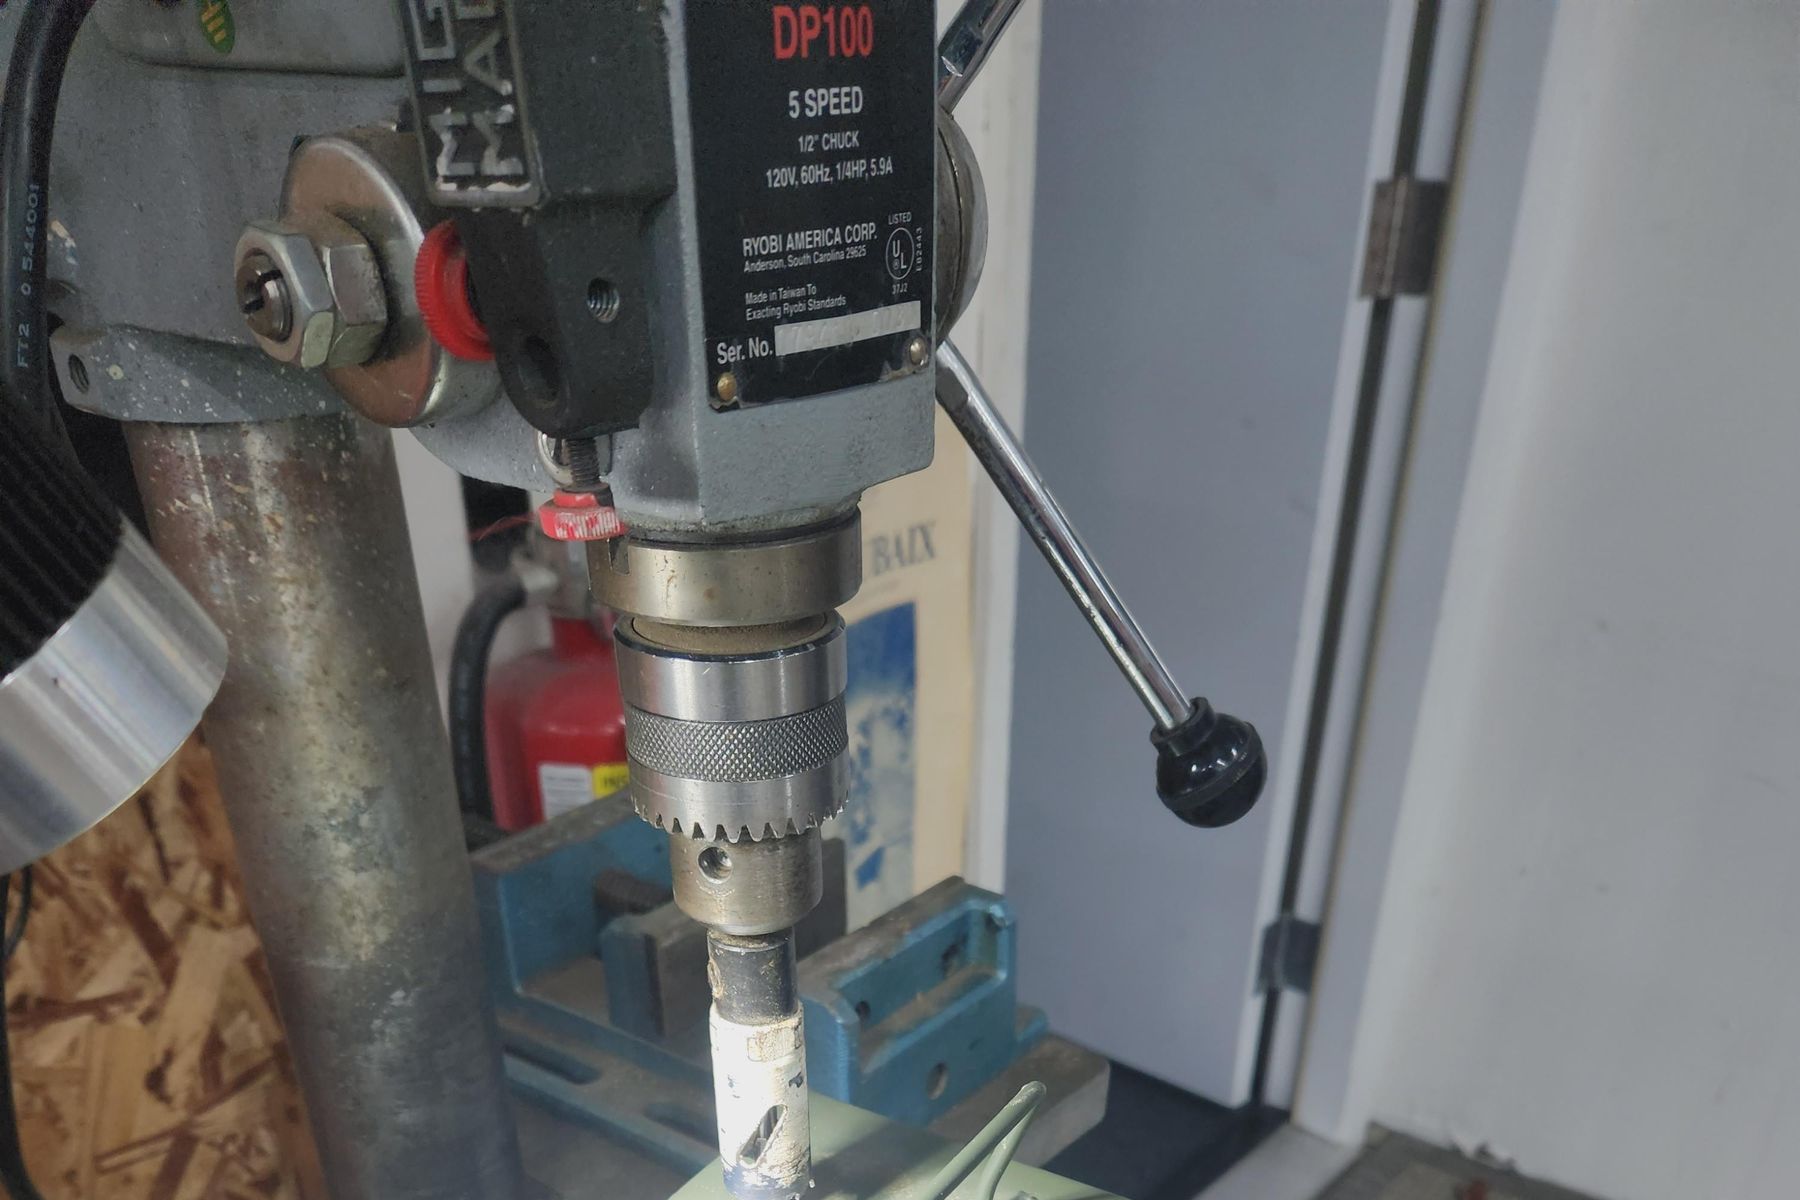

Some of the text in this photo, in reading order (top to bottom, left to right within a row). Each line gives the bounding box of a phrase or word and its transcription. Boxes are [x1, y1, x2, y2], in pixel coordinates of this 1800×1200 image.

[773, 5, 873, 59] DP100
[788, 86, 863, 119] 5 SPEED
[798, 131, 860, 152] 1/2" CHUCK
[766, 156, 893, 188] 120V, 60Hz, 1/4HP, 5.9A
[888, 212, 912, 225] LISTED
[743, 222, 878, 257] RYOBI AMERICA CORP.
[744, 244, 867, 273] Anderson, South Carolina 29625
[745, 283, 817, 305] Made in Taiwan To
[745, 294, 847, 320] Exacting Ryobi Standards
[716, 336, 773, 365] Ser. No.
